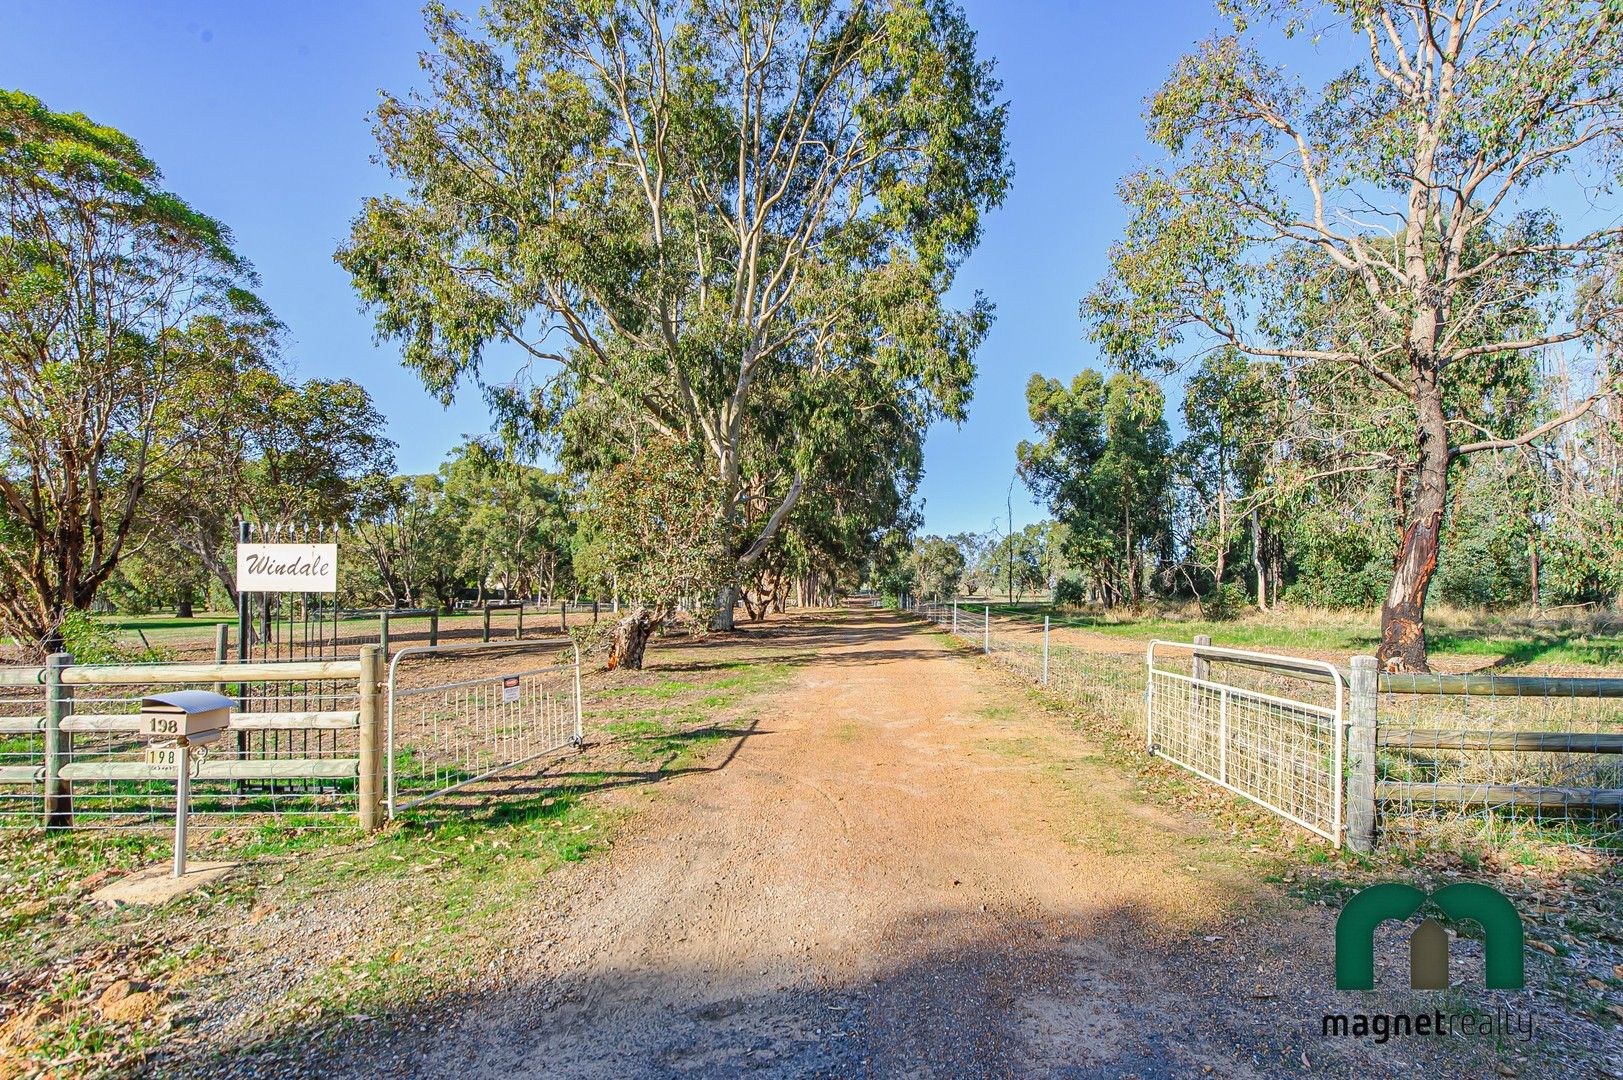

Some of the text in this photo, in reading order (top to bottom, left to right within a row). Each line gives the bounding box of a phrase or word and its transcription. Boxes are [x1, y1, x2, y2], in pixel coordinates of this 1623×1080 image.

[246, 553, 329, 576] Windale
[150, 718, 178, 733] 198
[150, 751, 175, 764] 198
